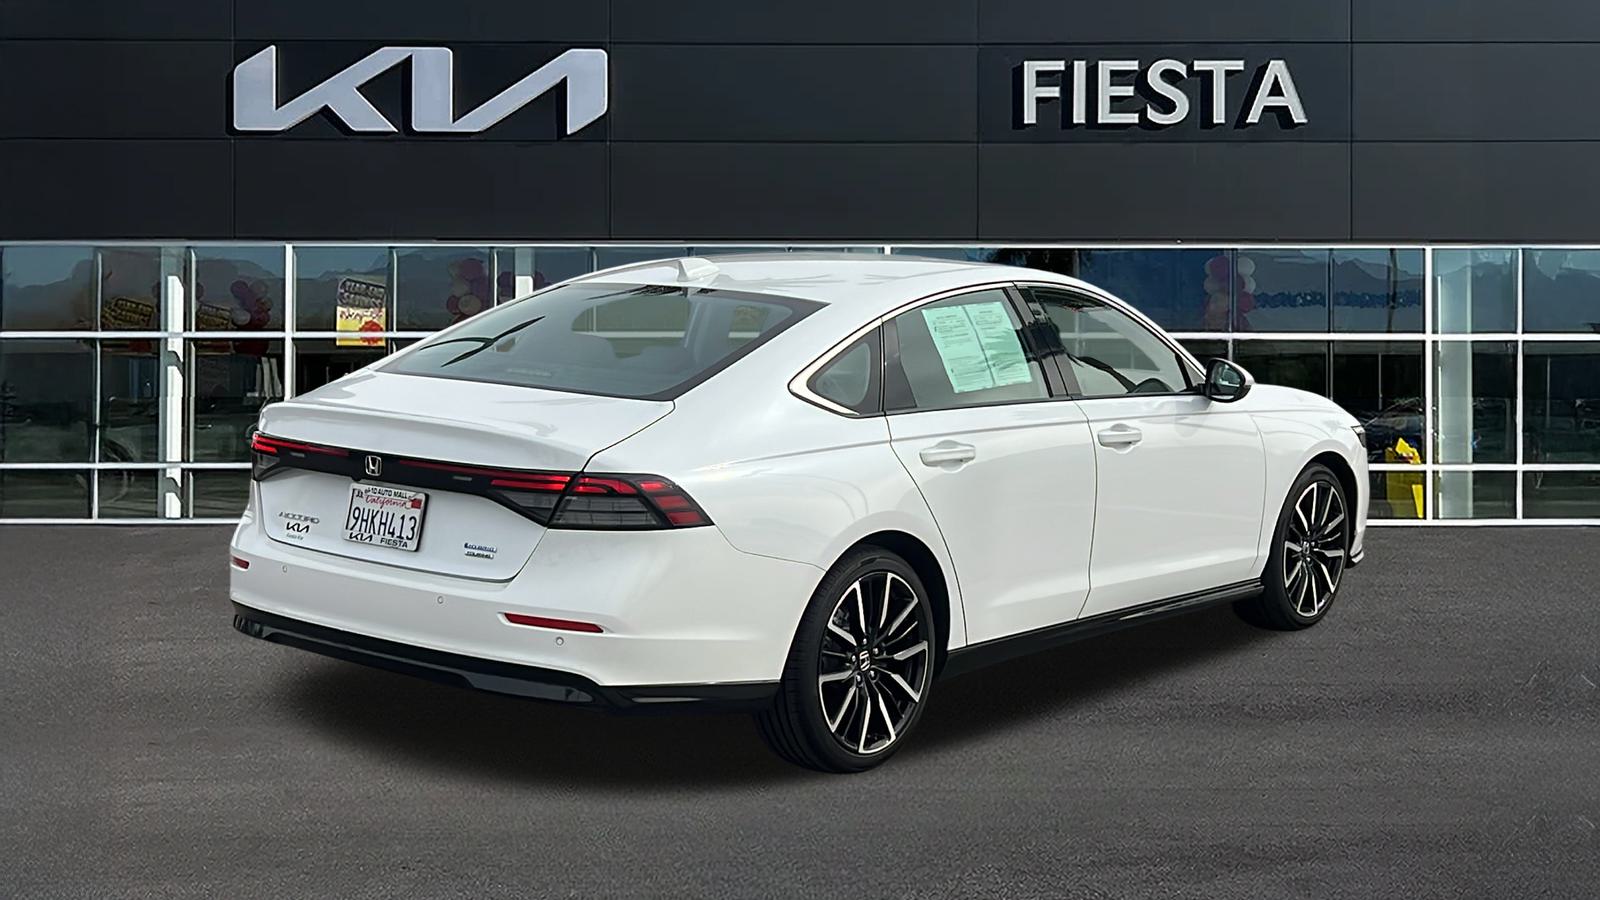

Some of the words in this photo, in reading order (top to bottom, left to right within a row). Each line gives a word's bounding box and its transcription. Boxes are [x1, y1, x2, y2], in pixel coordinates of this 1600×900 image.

[234, 45, 608, 135] KIA
[1023, 59, 1308, 125] FIESTA
[378, 489, 392, 497] AUTO
[393, 491, 407, 499] MALL
[350, 506, 417, 540] 9HKH413
[380, 538, 408, 548] FIESTA
